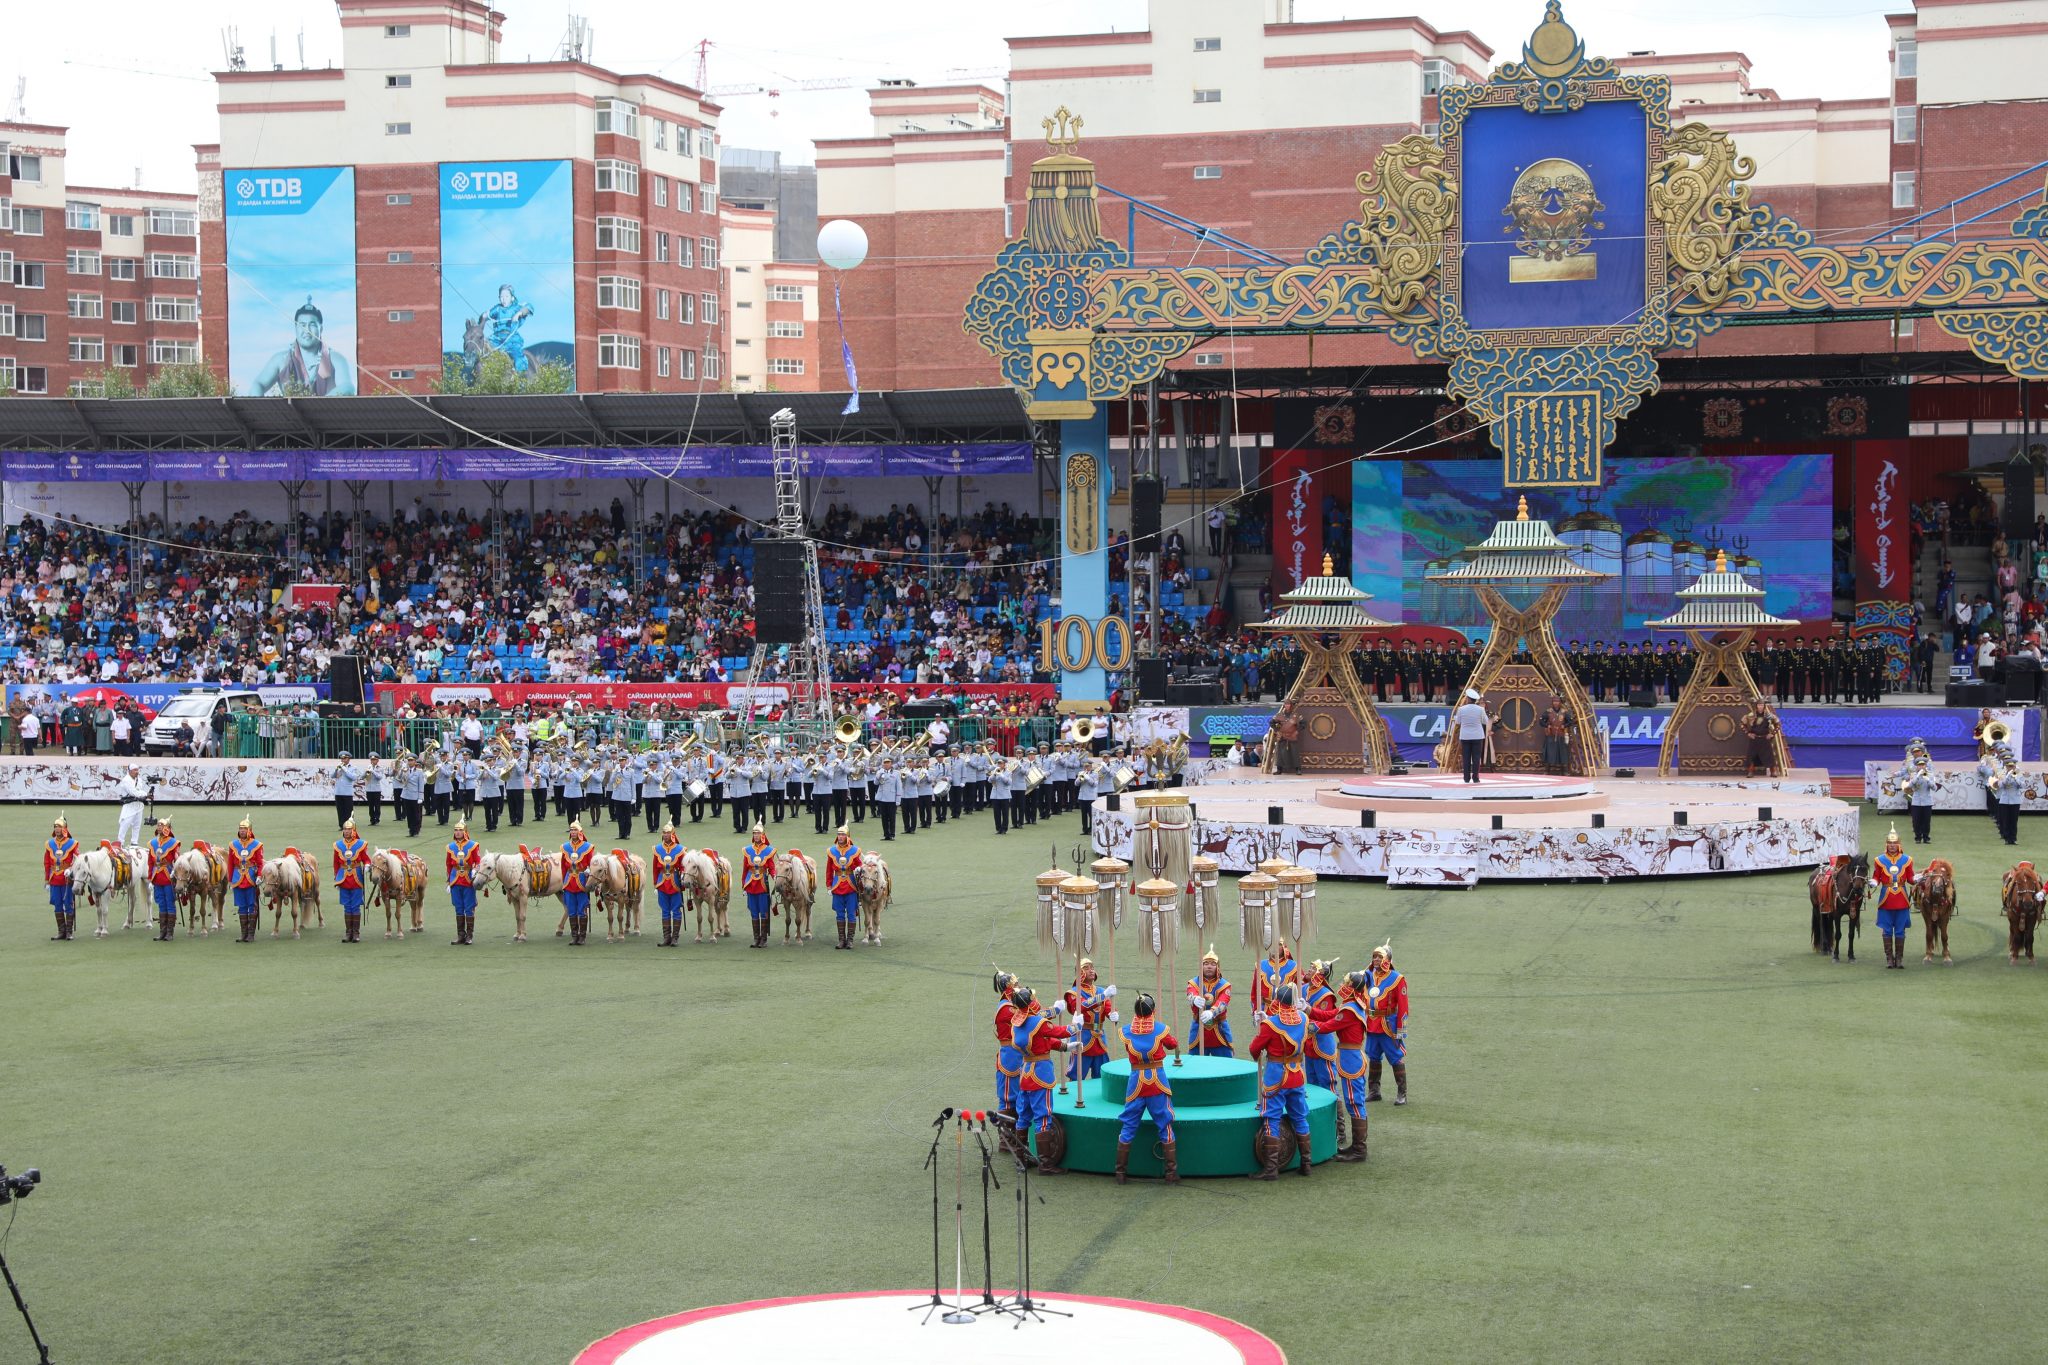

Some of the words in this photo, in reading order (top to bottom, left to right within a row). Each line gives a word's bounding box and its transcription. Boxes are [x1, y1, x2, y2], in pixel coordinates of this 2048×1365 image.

[256, 178, 302, 198] TDB
[471, 171, 518, 191] TDB
[1035, 615, 1132, 673] 100
[143, 695, 164, 704] БҮР
